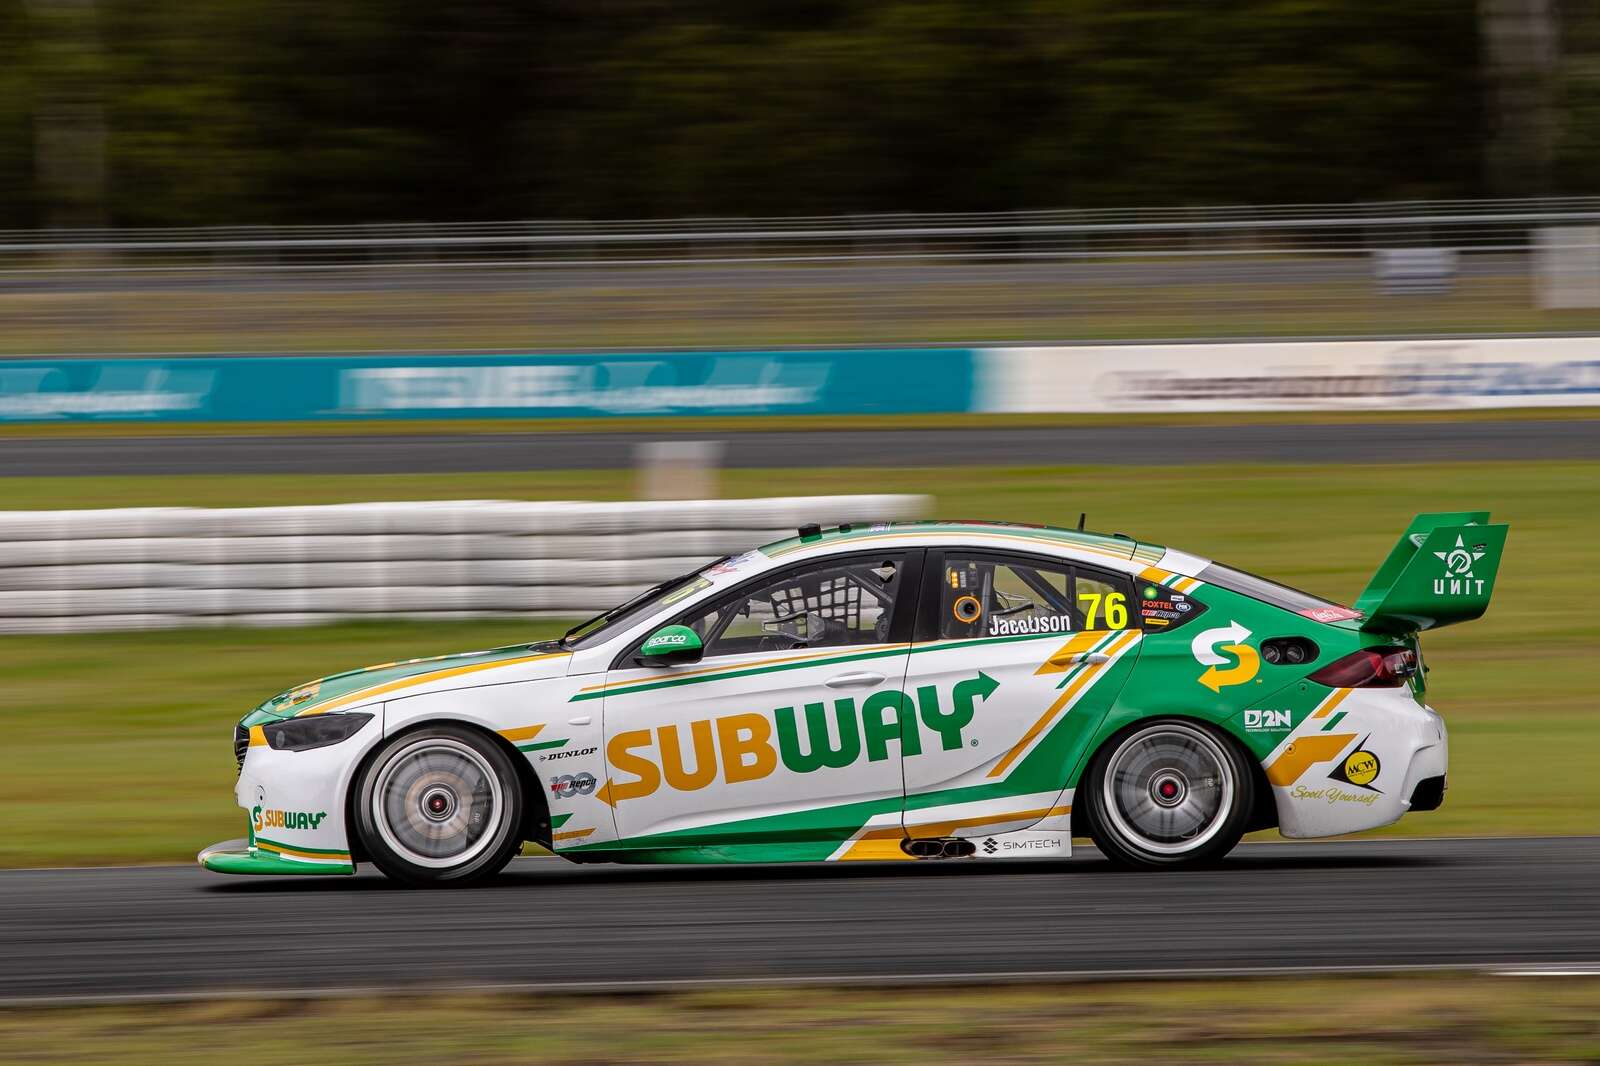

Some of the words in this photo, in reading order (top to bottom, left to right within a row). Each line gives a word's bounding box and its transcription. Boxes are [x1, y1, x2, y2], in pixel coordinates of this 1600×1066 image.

[1078, 592, 1128, 631] 76
[1142, 600, 1174, 610] FOXTEL
[989, 614, 1071, 636] Jacobson
[595, 670, 1001, 809] SUBWAY
[547, 747, 598, 761] DUNLOP
[569, 778, 598, 790] Repco
[265, 809, 328, 830] SUBWAY
[1003, 839, 1061, 850] SIMTECH
